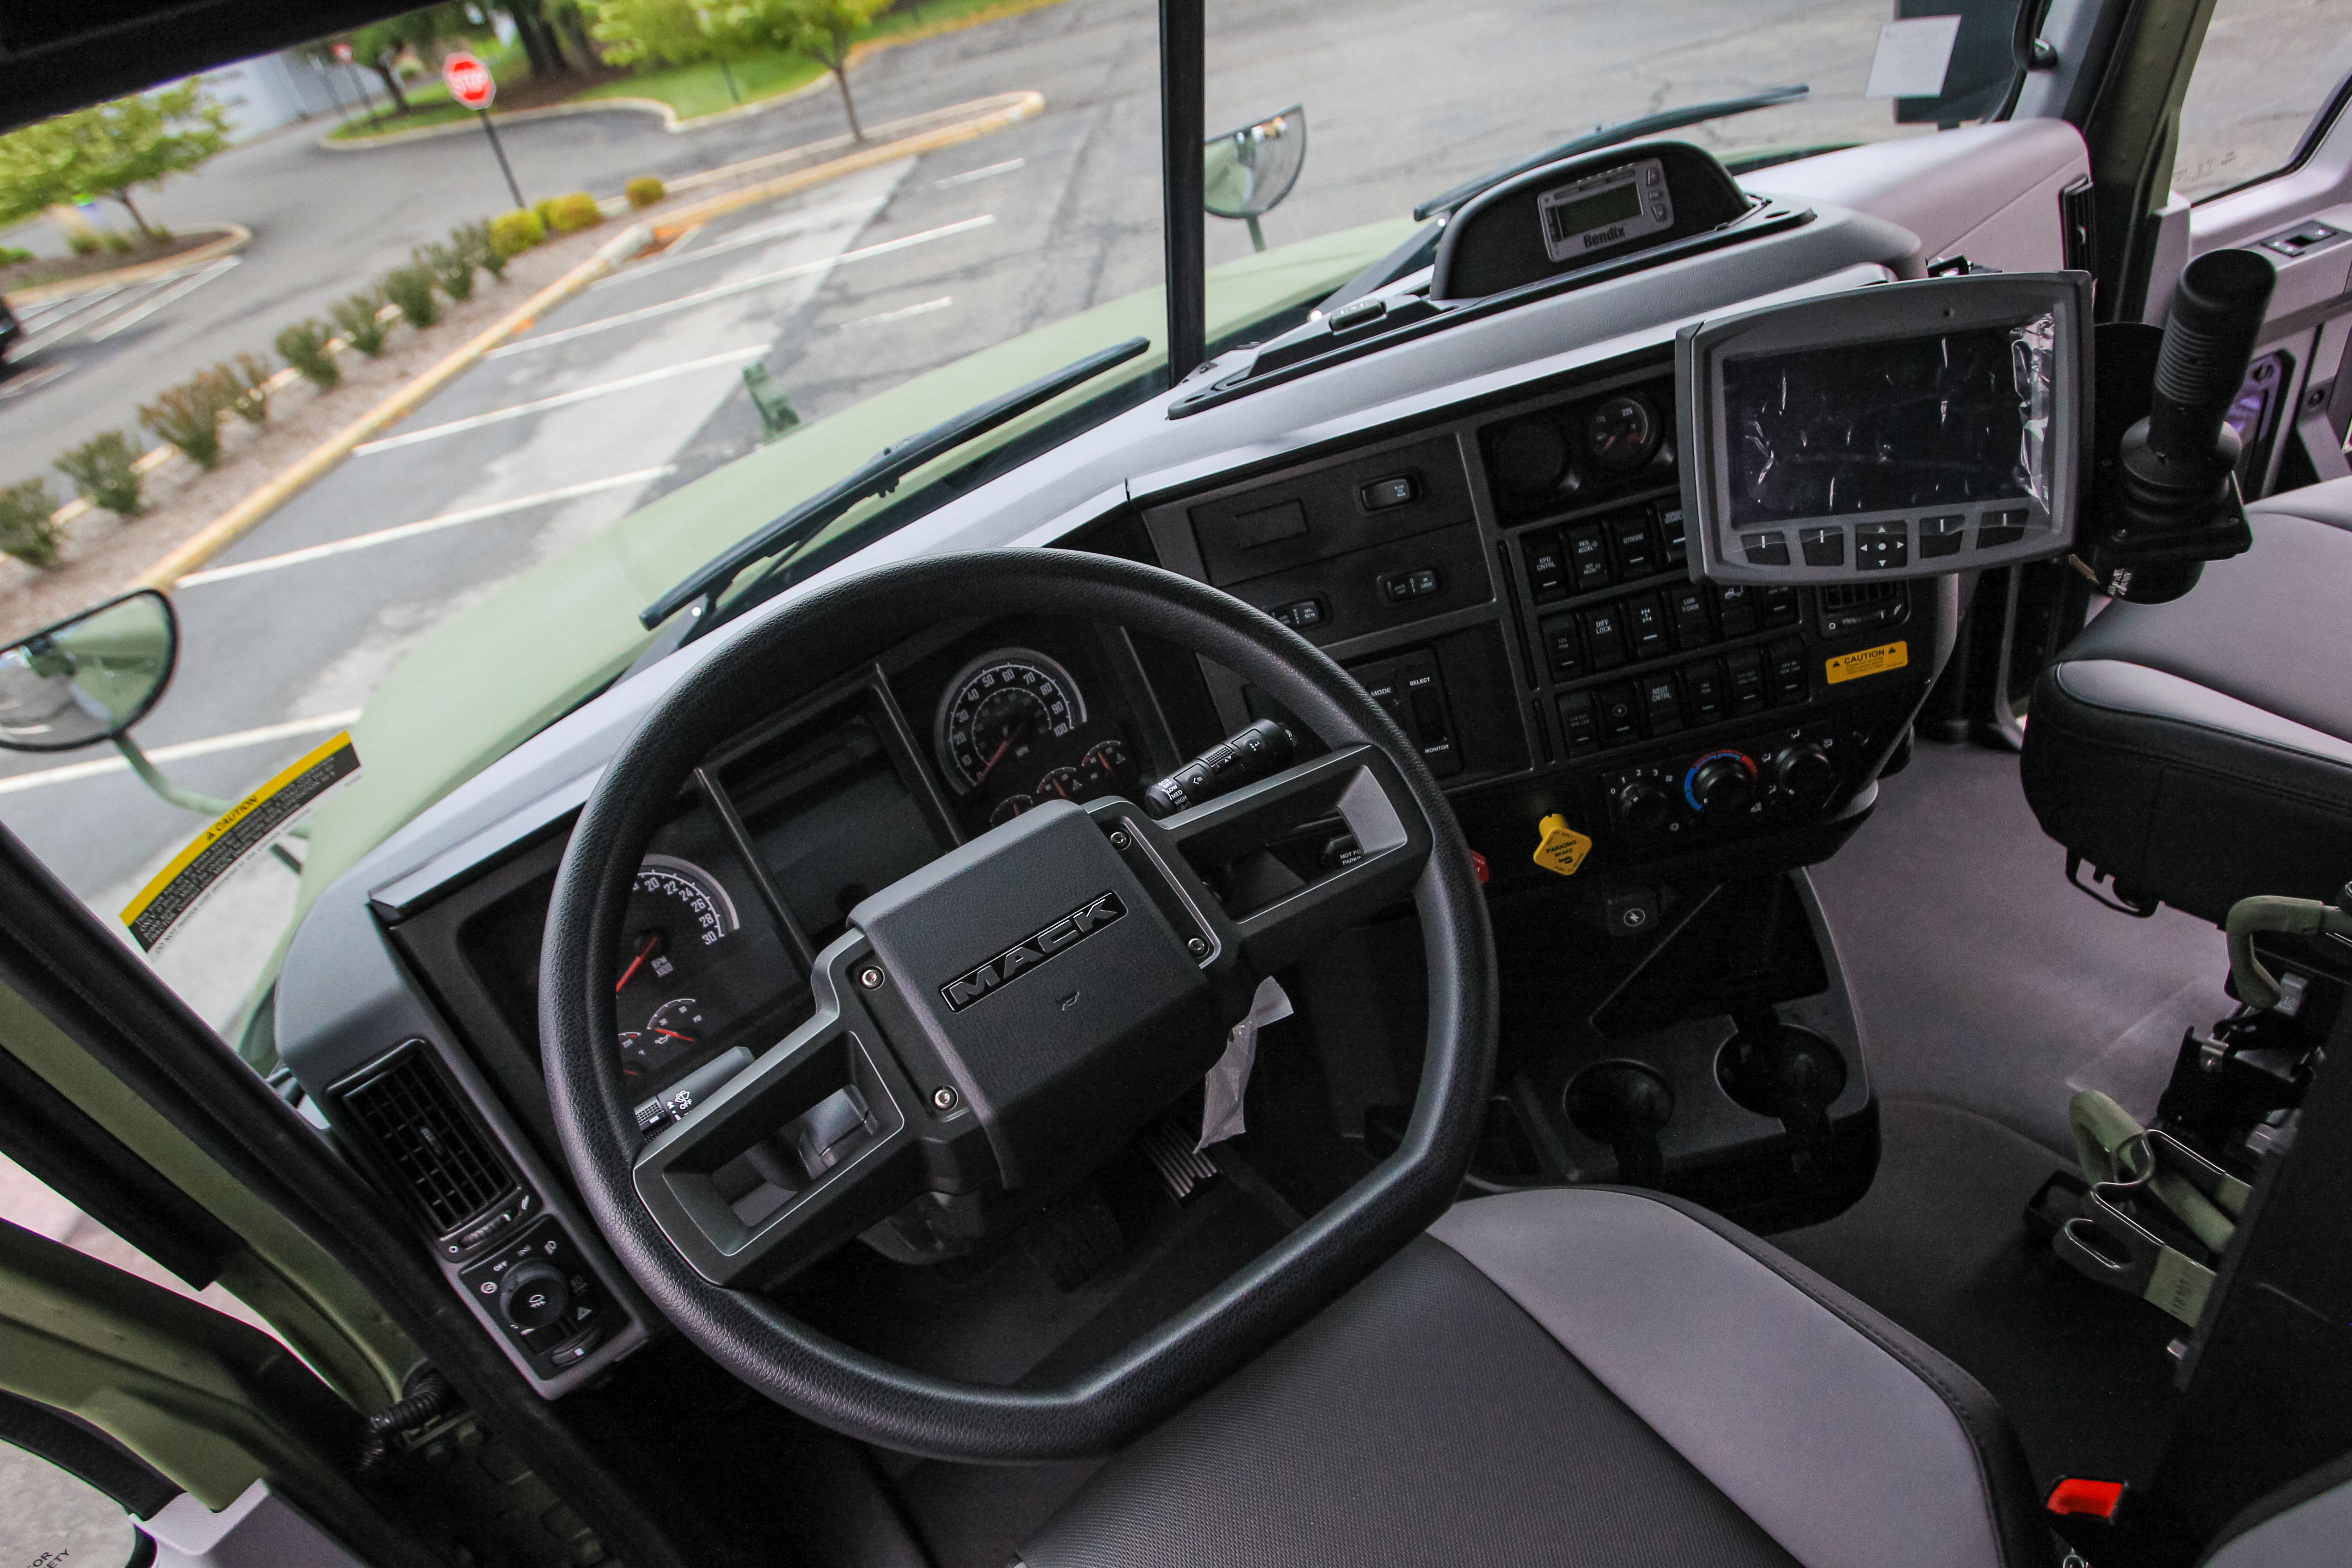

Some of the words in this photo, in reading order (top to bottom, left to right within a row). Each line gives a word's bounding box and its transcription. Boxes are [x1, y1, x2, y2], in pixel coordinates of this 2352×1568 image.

[1583, 226, 1625, 248] Bendix
[1623, 533, 1644, 544] STROBE
[1578, 545, 1594, 553] ACCEL
[1537, 562, 1556, 571] CNTRL
[1683, 597, 1695, 605] LOW
[1596, 619, 1609, 627] DIFF
[1596, 625, 1612, 634] LOCK
[1844, 649, 1885, 664] CAUTION
[982, 674, 995, 687] 50
[1002, 669, 1015, 682] 60
[1023, 672, 1036, 685] 70
[1409, 677, 1431, 686] SELECT
[967, 688, 980, 701] 40
[1040, 682, 1053, 695] 80
[1371, 687, 1392, 696] MODE
[1652, 686, 1668, 695] NEUT
[1652, 692, 1672, 702] CNTRL
[1051, 701, 1064, 714] 90
[956, 710, 969, 723] 30
[1054, 723, 1068, 737] 100
[954, 732, 967, 745] 20
[1424, 744, 1449, 753] MONITOR
[961, 755, 972, 767] 10
[1167, 784, 1178, 794] LOW
[1171, 790, 1183, 799] MED
[1174, 796, 1188, 806] HIGH
[216, 796, 258, 832] CAUTION
[1546, 840, 1577, 854] PARKING
[1555, 848, 1573, 857] BRAKE
[644, 877, 660, 892] 20
[663, 880, 679, 895] 22
[679, 888, 694, 902] 24
[691, 897, 706, 913] 26
[698, 913, 714, 928] 28
[702, 930, 717, 946] 30
[949, 898, 1118, 1005] MACK
[651, 955, 668, 969] RPM
[679, 1098, 693, 1110] OFF
[493, 1261, 508, 1272] OFF
